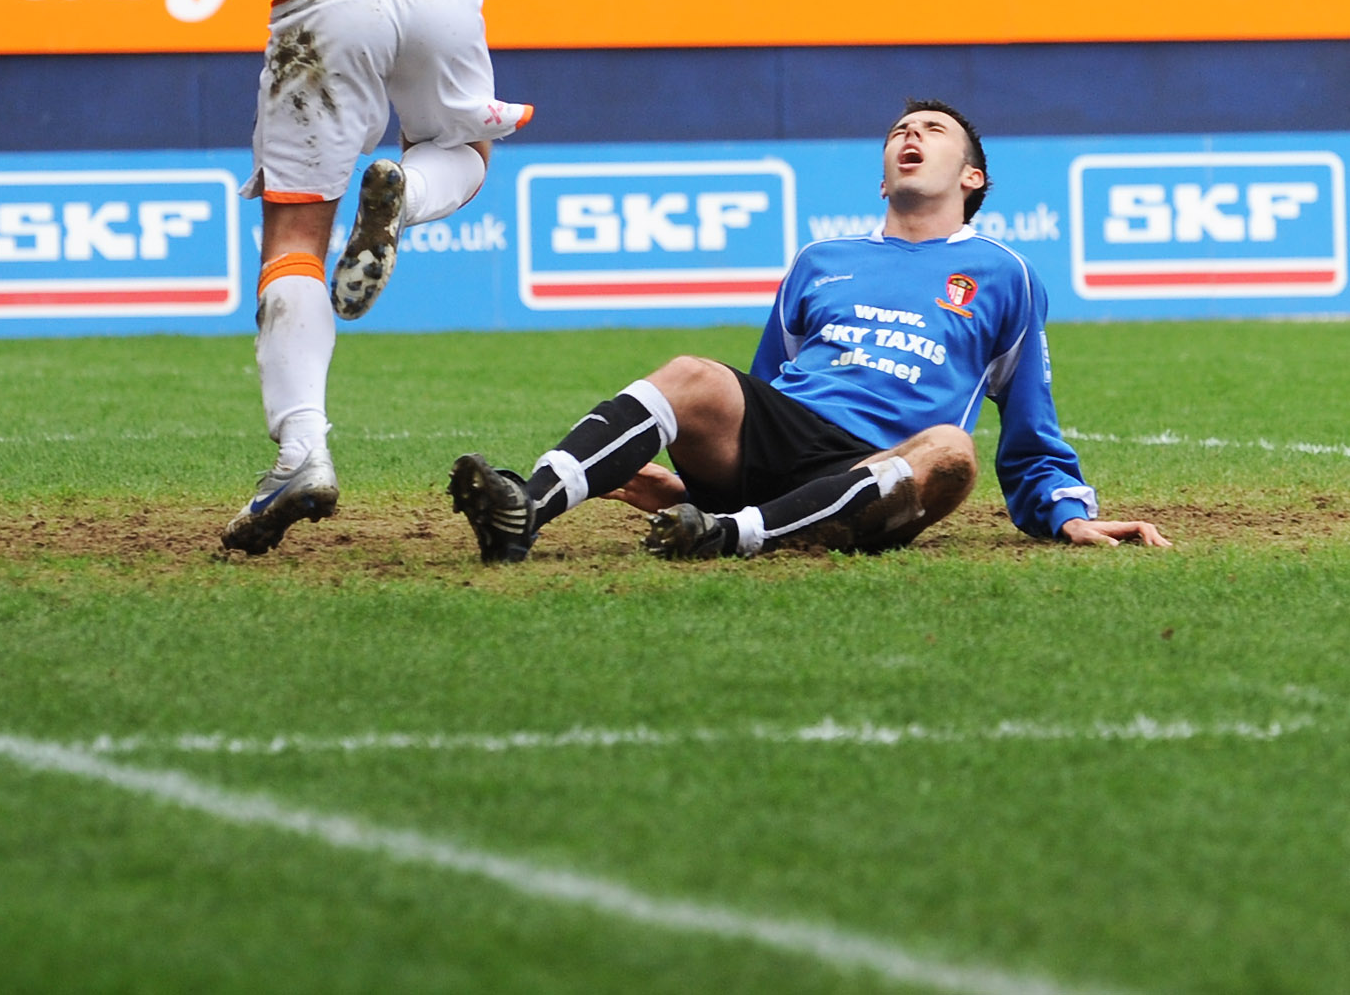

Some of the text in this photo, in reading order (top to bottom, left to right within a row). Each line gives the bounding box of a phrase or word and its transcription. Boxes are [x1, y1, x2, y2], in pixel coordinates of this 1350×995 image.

[551, 192, 769, 253] SKF
[1103, 183, 1318, 244] SKF
[854, 304, 927, 328] www.
[820, 323, 946, 366] SKY TAXIS
